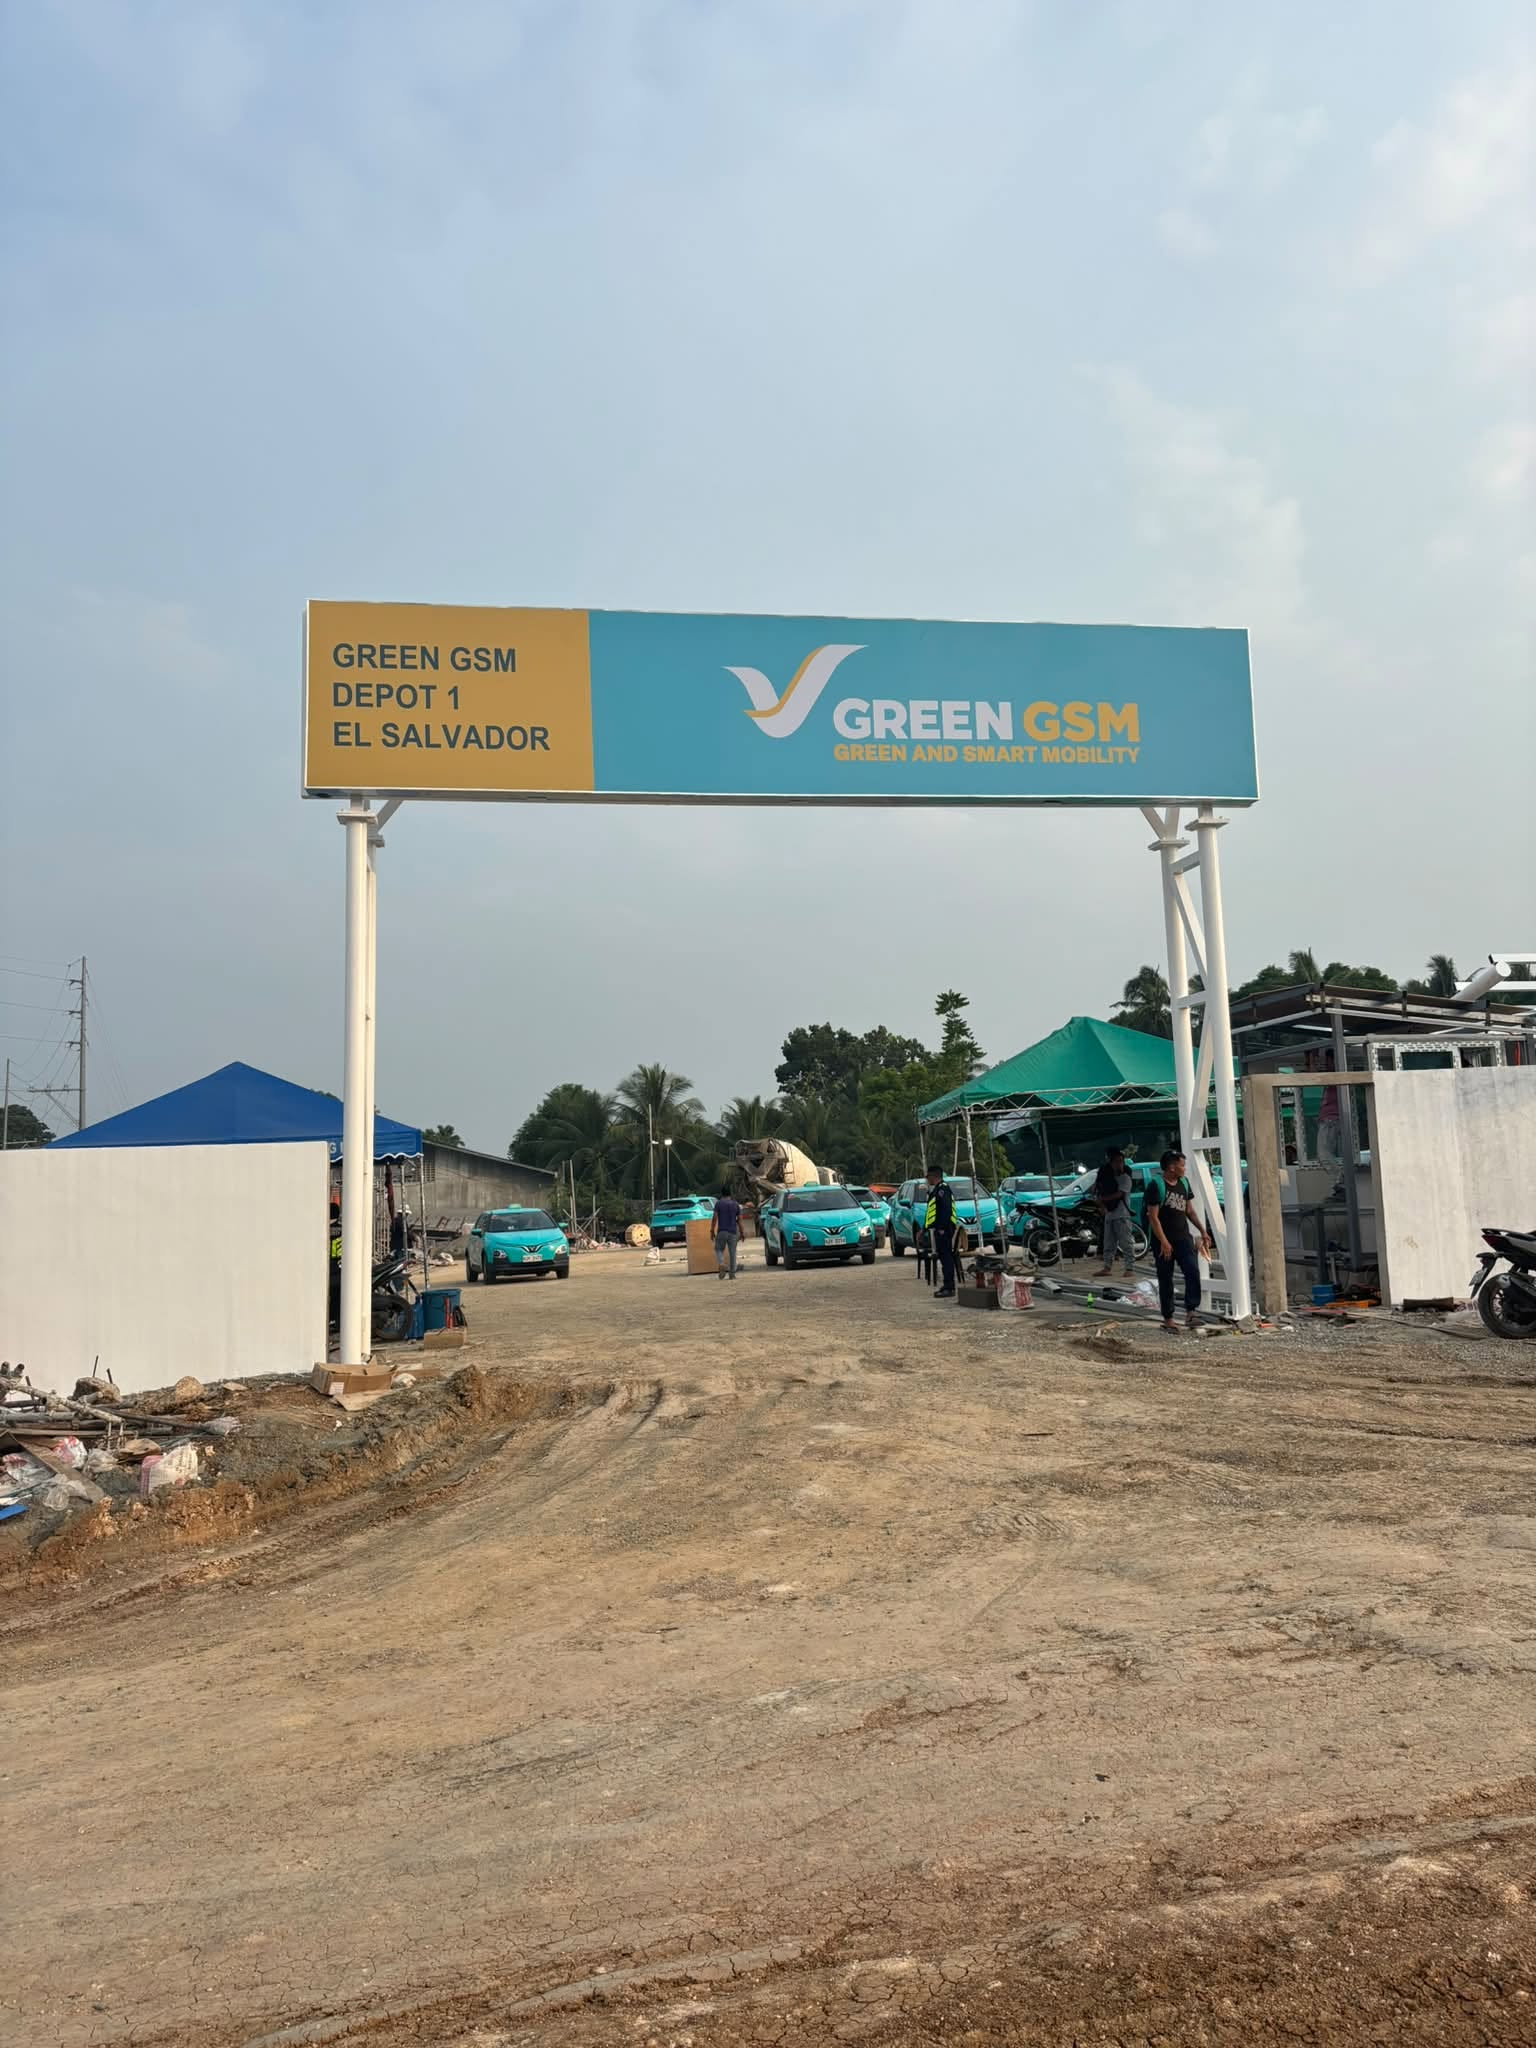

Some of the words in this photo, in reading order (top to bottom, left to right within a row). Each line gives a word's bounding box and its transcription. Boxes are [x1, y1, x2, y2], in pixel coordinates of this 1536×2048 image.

[332, 642, 440, 671] GREEN
[449, 646, 516, 673] GSM
[332, 682, 438, 709] DEPOT
[447, 685, 459, 709] 1
[832, 697, 1013, 741] GREEN
[1023, 701, 1141, 743] GSM
[333, 721, 372, 747] EL
[381, 722, 551, 751] SALVADOR
[833, 743, 907, 762] GREEN
[911, 744, 959, 763] AND
[962, 744, 1038, 763] SMART
[1041, 745, 1140, 764] MOBILITY
